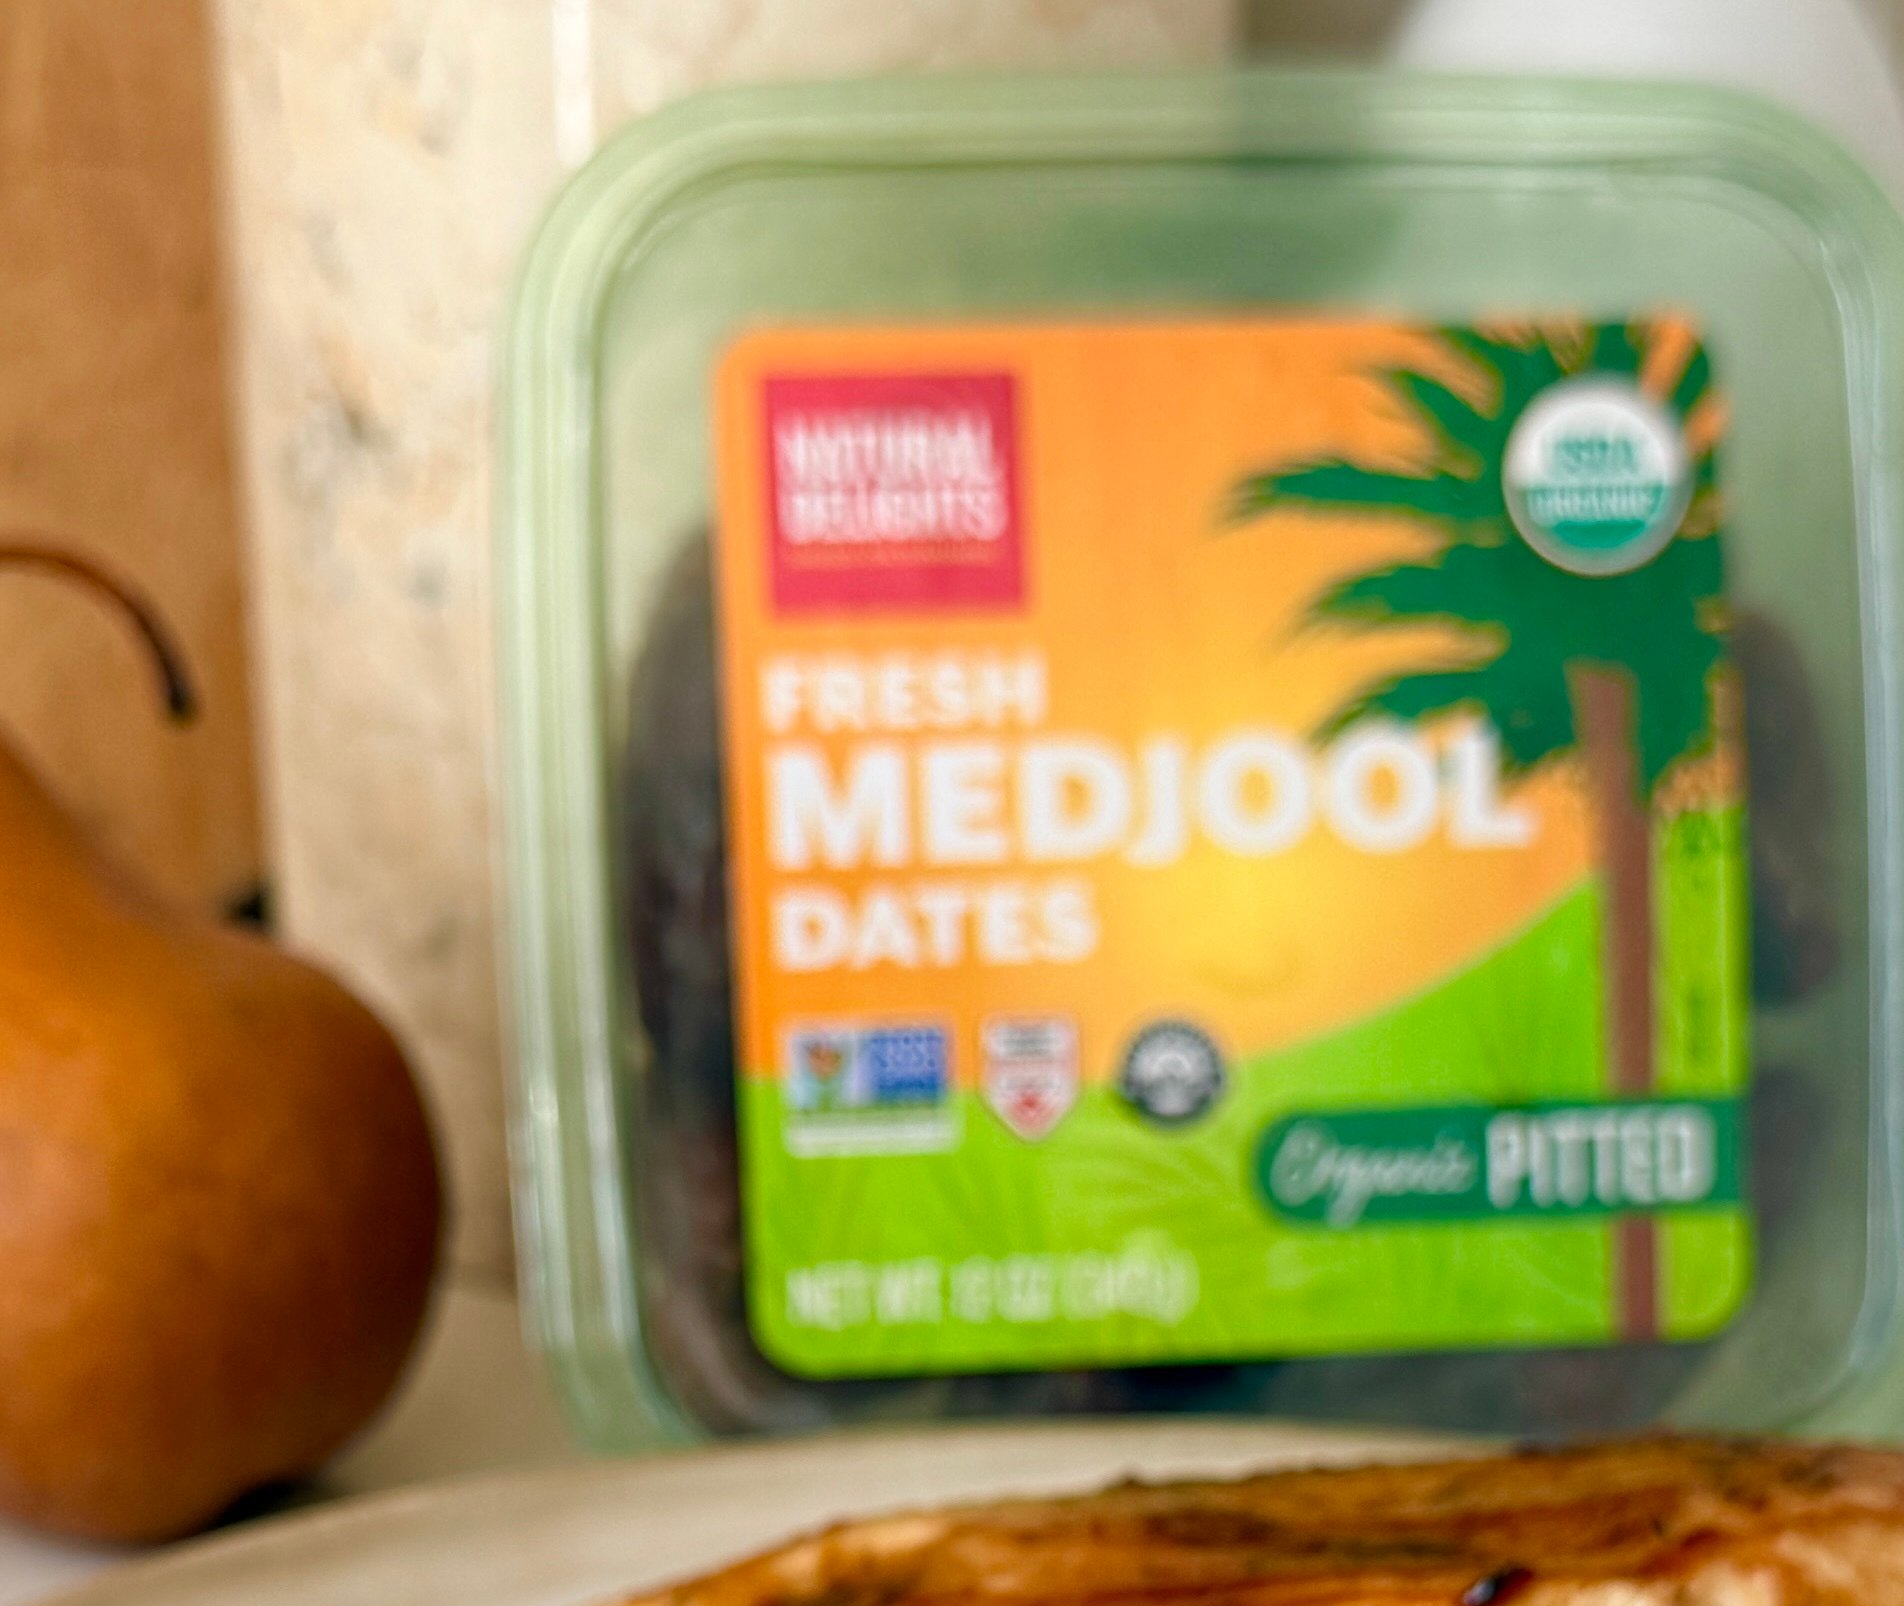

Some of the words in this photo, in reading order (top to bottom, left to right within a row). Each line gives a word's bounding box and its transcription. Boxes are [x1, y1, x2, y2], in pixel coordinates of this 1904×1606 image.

[762, 650, 1048, 731] FRESH
[768, 720, 1538, 869] MEDJOOL
[773, 879, 1099, 972] DATES
[1270, 1118, 1479, 1229] Organic
[1486, 1105, 1717, 1208] PITTED
